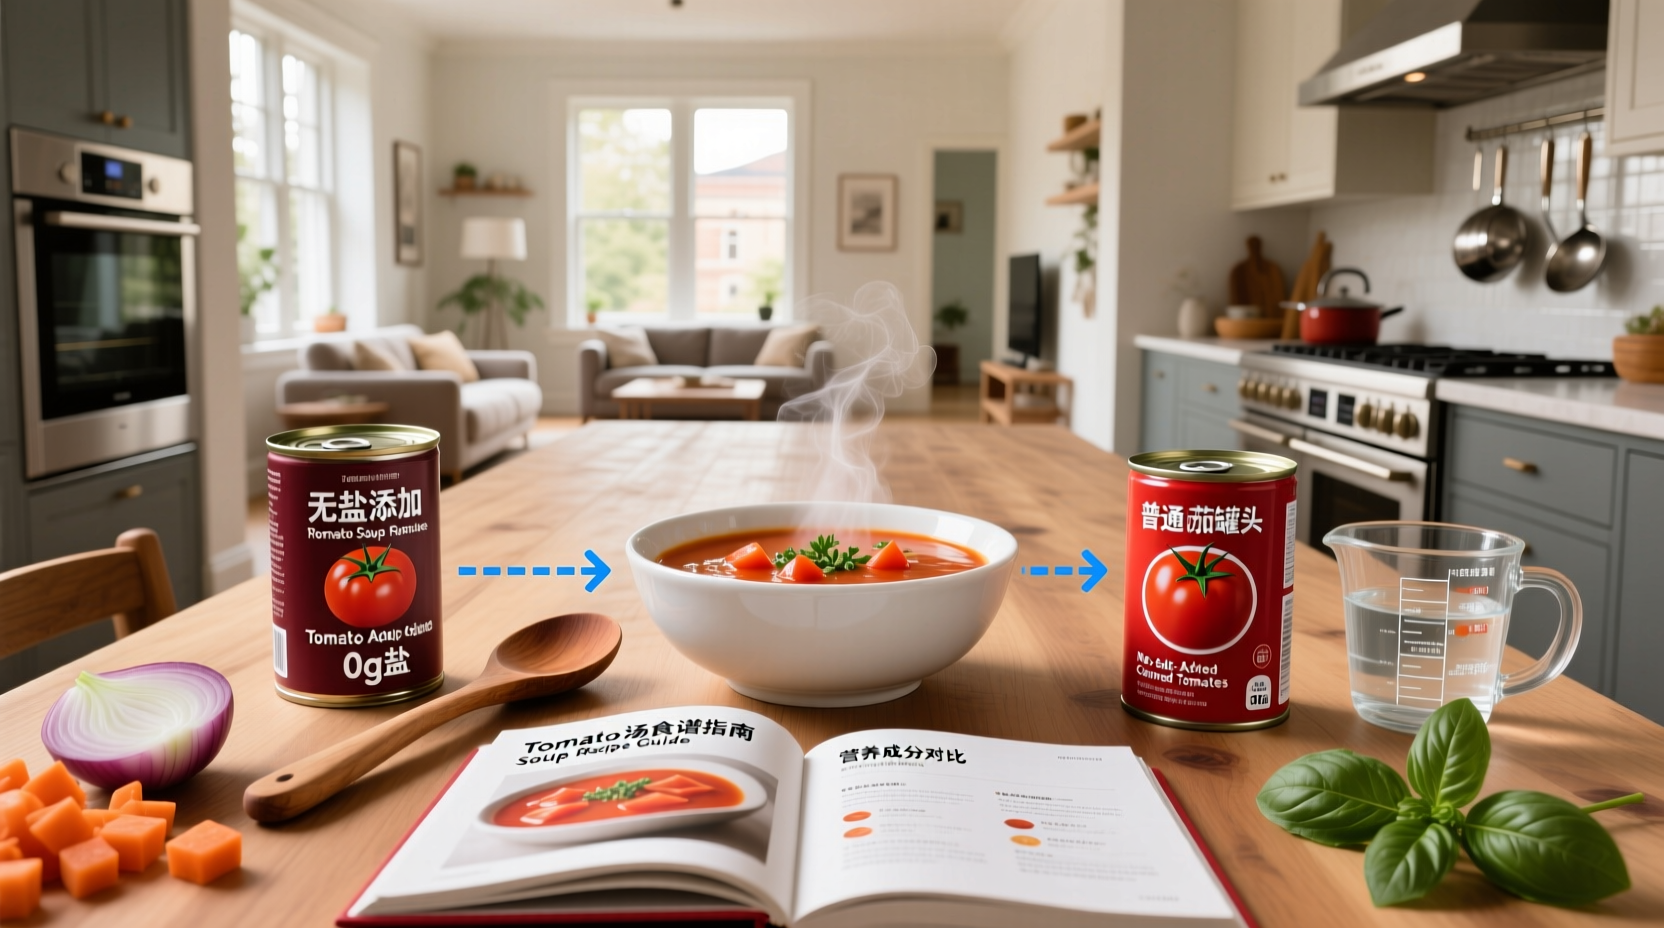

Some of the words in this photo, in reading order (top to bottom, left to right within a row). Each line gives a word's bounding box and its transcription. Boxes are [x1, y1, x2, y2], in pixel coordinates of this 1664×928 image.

[307, 486, 422, 523] 无盐添加
[305, 628, 364, 645] Tomato
[343, 645, 411, 686] 0g盐
[516, 751, 569, 766] Soup
[839, 744, 967, 764] 营养成分对比
